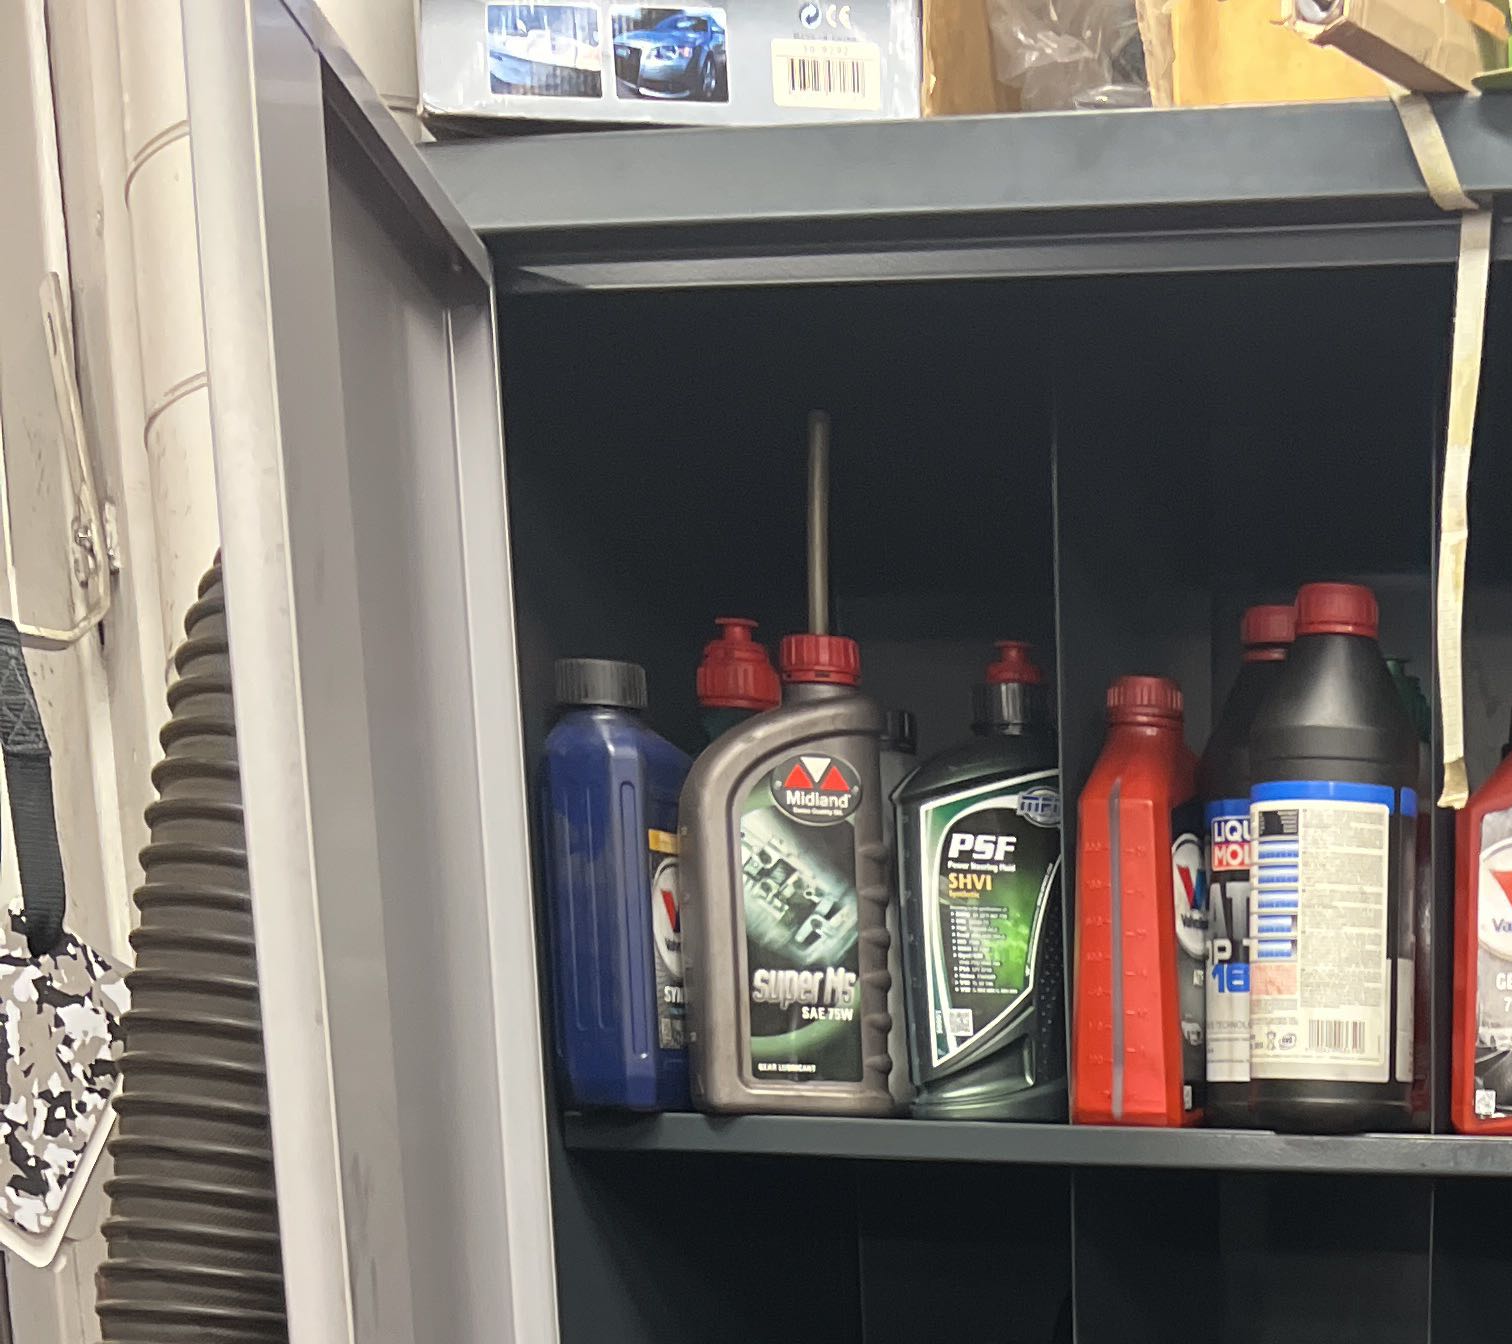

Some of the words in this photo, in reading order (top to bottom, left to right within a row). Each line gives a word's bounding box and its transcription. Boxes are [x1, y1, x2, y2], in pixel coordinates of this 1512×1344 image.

[786, 788, 851, 809] Midland
[1214, 819, 1250, 843] LIQU
[948, 833, 1017, 860] PSF
[1213, 843, 1250, 867] MOL
[948, 872, 993, 891] SHVI
[801, 1007, 826, 1020] SAE
[828, 1007, 854, 1021] 75W
